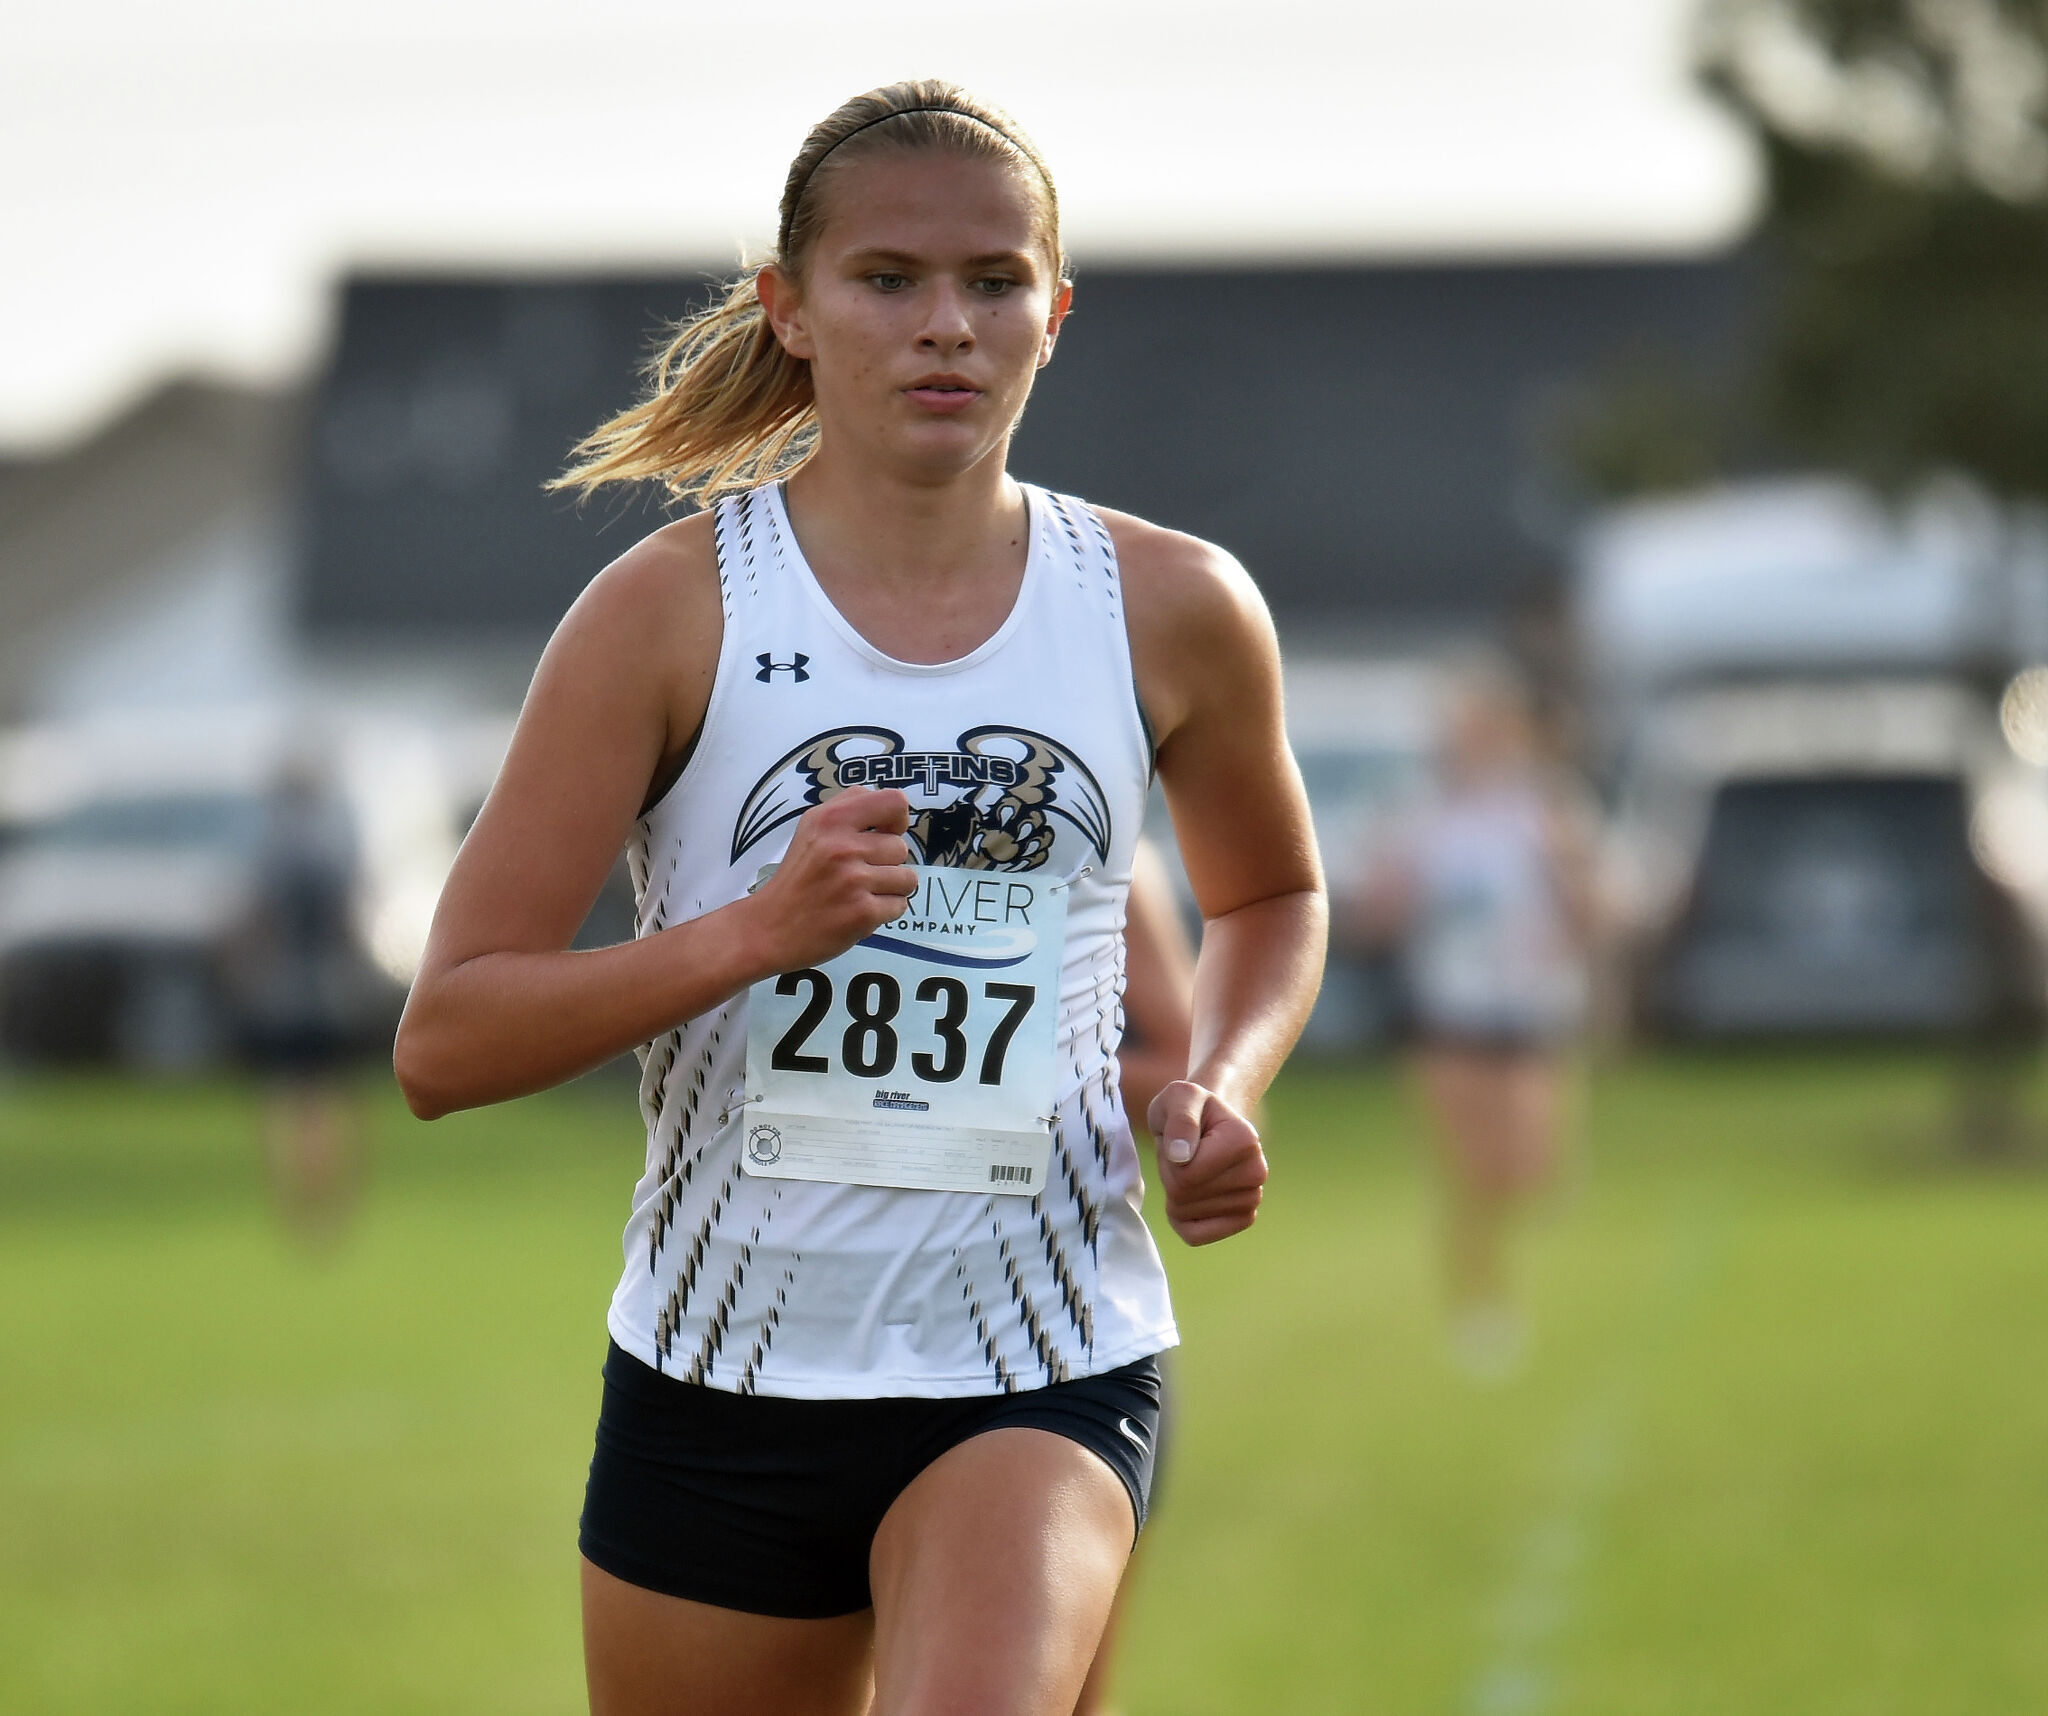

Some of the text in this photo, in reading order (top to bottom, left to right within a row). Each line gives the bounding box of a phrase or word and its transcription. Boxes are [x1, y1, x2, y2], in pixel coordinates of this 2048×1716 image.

[839, 754, 1017, 794] GRIFFINS
[885, 920, 977, 935] COMPANY
[771, 968, 1036, 1086] 2837
[875, 1089, 911, 1100] big river
